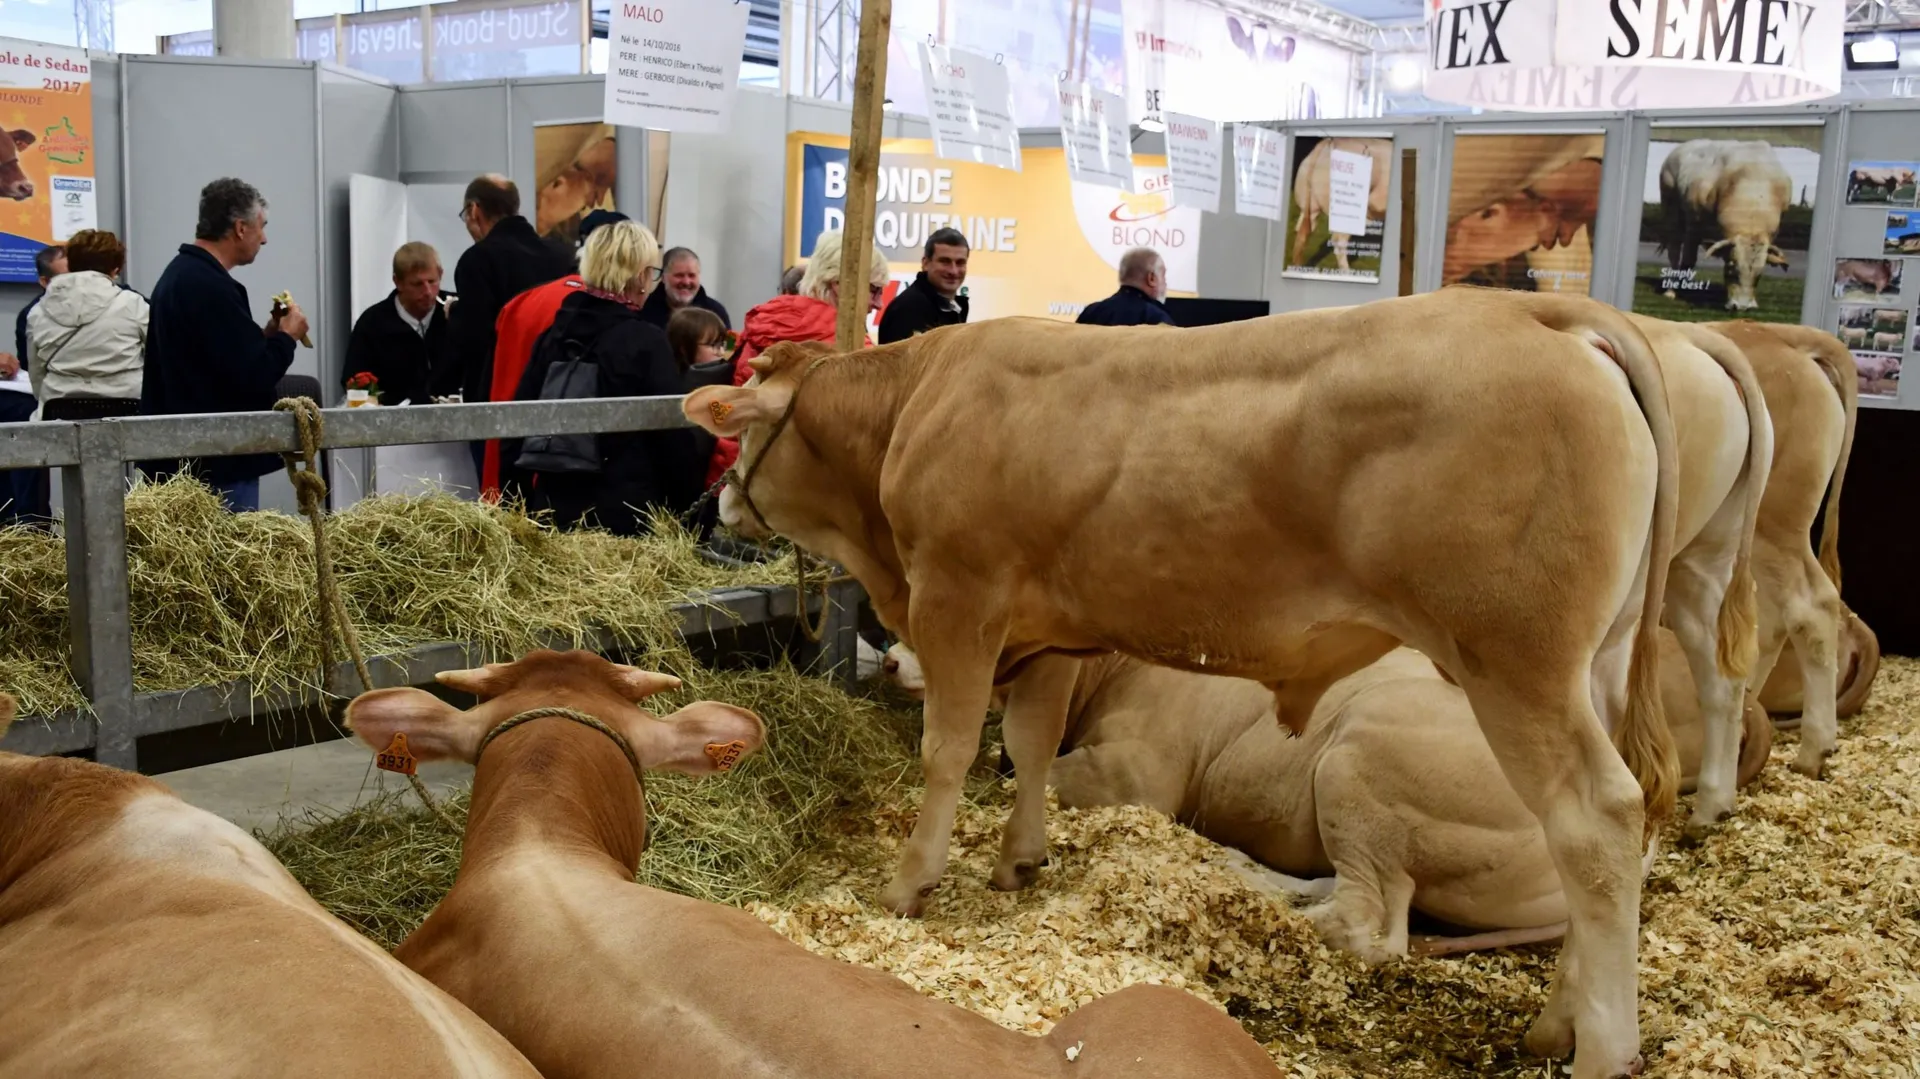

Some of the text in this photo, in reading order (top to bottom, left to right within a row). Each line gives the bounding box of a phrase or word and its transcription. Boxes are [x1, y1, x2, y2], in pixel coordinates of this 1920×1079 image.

[623, 3, 664, 23] MALO
[1607, 0, 1816, 72] SEMEX
[24, 54, 41, 68] de
[45, 57, 88, 73] Sedan
[620, 51, 637, 62] PERE
[643, 55, 673, 67] HENRICO
[618, 67, 639, 79] MERE
[644, 71, 675, 84] GERBOISE
[43, 77, 82, 93] 2017
[1112, 225, 1186, 248] BLOND
[1660, 267, 1697, 280] Simply
[1662, 279, 1681, 289] the
[1681, 280, 1704, 290] best
[380, 754, 412, 770] 3931
[719, 743, 744, 769] 3931
